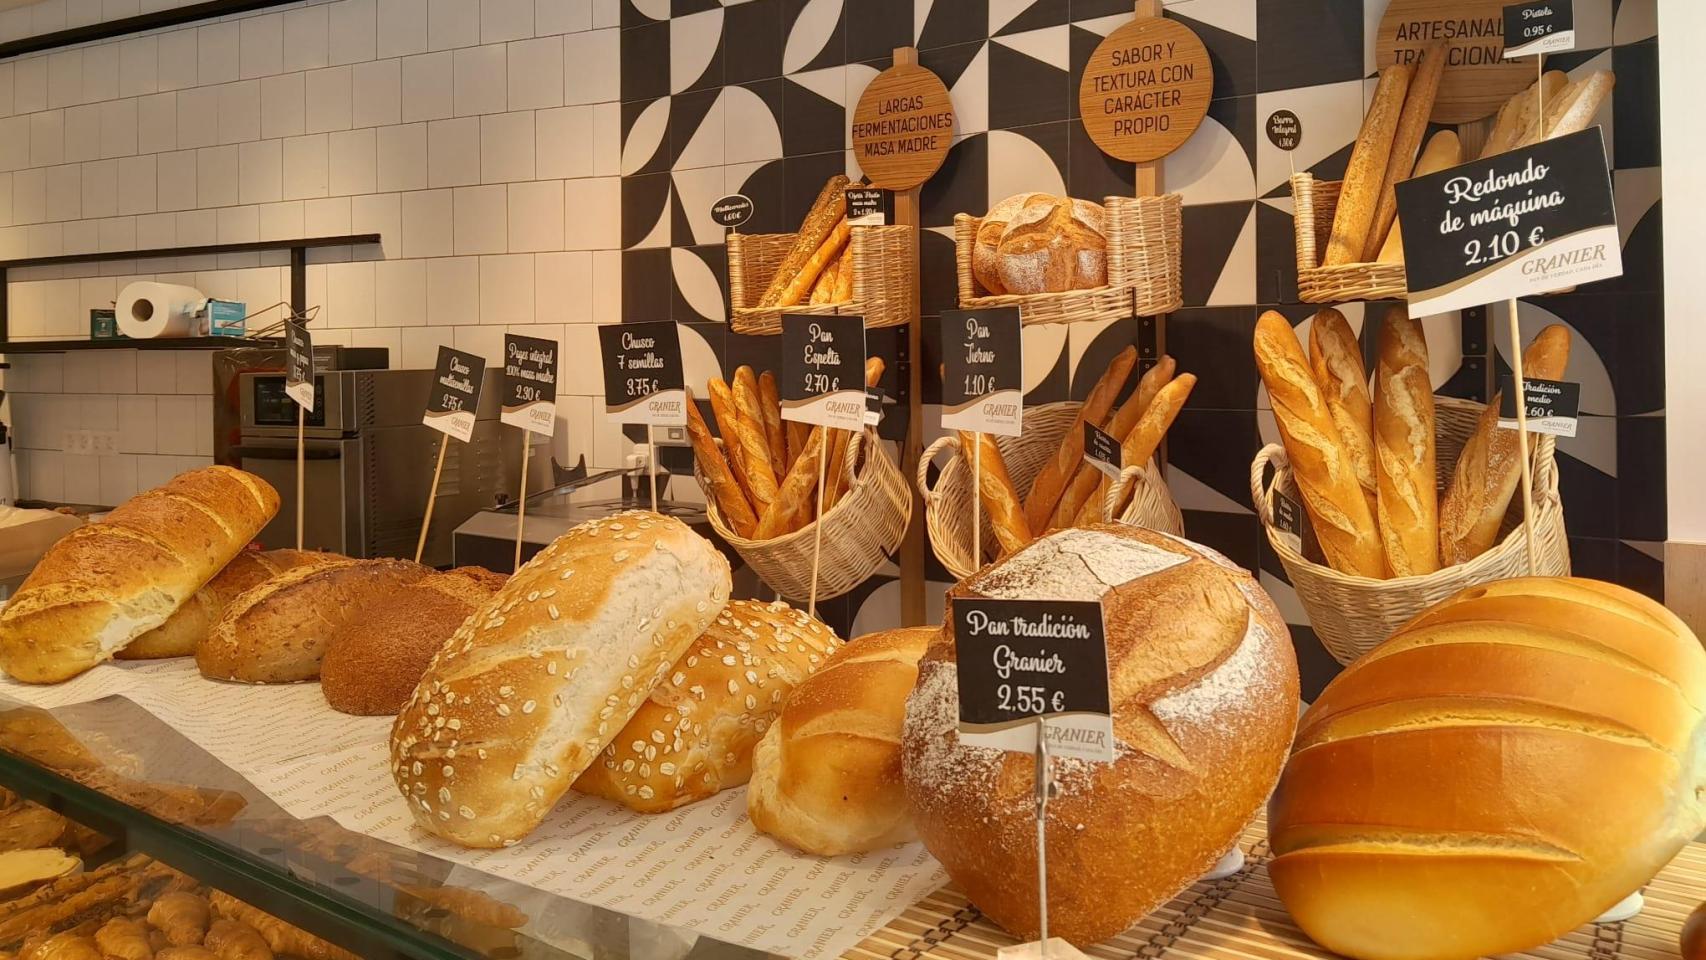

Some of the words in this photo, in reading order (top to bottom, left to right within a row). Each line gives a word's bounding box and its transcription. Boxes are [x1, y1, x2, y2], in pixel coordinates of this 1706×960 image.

[1522, 6, 1553, 20] Pistola
[1112, 44, 1162, 67] SABOR
[1167, 42, 1176, 58] Y
[1094, 69, 1157, 92] TEXTURA
[1161, 64, 1194, 83] CON
[879, 95, 923, 115] LARGAS
[1104, 89, 1181, 115] CARÁCTER
[852, 113, 953, 138] FERMENTACIONES
[1114, 114, 1170, 136] PROPIO
[865, 141, 895, 157] MASA
[898, 136, 937, 153] MADRE
[1444, 157, 1550, 204] Redondo
[1439, 209, 1465, 234] de
[1470, 189, 1566, 227] máquina
[1528, 226, 1545, 247] €
[1522, 244, 1606, 275] GRANIER
[808, 323, 834, 342] Pan
[966, 318, 990, 339] Pan
[622, 332, 655, 350] Chusco
[529, 347, 553, 369] integral
[617, 354, 625, 369] 7
[628, 352, 664, 369] semillas
[804, 344, 841, 370] Espelta
[964, 343, 996, 364] Tierno
[652, 380, 659, 393] €
[832, 377, 840, 392] €
[988, 376, 995, 393] €
[1522, 381, 1561, 394] Tradición
[649, 401, 681, 413] GRANIER
[825, 400, 860, 417] GRANIER
[1527, 394, 1552, 404] medio
[983, 403, 1018, 419] GRANIER
[1541, 420, 1573, 431] GRANIER
[966, 609, 1010, 636] Pan
[1010, 613, 1090, 640] tradición
[993, 644, 1066, 679] Granier
[1051, 691, 1065, 712] €
[567, 831, 612, 863] GRANIER
